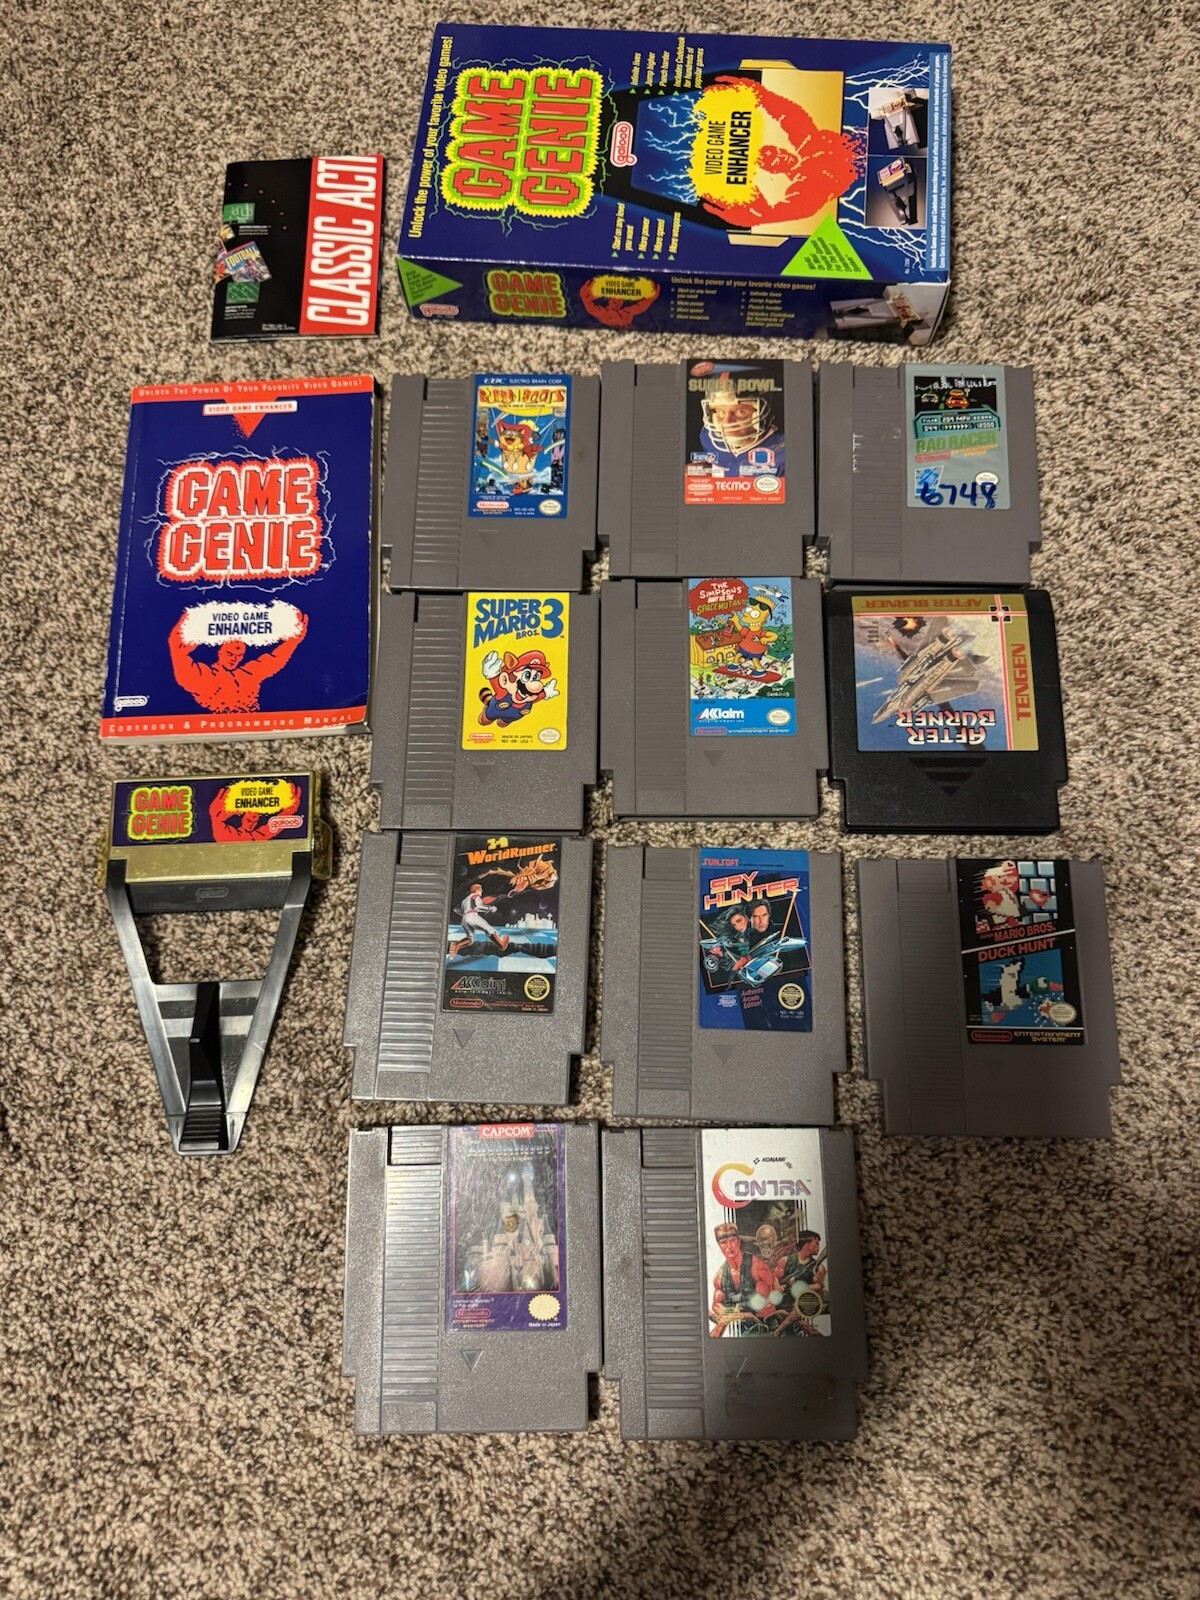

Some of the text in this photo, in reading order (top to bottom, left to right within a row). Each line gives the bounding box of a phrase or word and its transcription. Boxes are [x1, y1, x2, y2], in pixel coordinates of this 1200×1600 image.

[673, 37, 685, 87] Includes Codebook
[694, 48, 704, 88] popular games
[645, 71, 655, 86] Jump
[660, 70, 668, 87] Punch
[408, 36, 453, 237] Unlock the power of your favorite video games!
[452, 75, 526, 199] GAME
[520, 75, 593, 206] GENIE
[616, 126, 634, 164] galoob
[705, 121, 725, 174] VIDEO GAME
[726, 111, 751, 185] ENHANCER
[638, 217, 650, 251] More power
[654, 219, 665, 252] More speed
[669, 212, 681, 253] More weapons
[306, 216, 375, 326] CLASSIC
[492, 272, 560, 295] GAME
[601, 287, 641, 297] ENHANCER
[621, 281, 635, 289] GAME
[773, 281, 790, 289] video
[493, 293, 564, 315] GENIE
[688, 379, 776, 391] SUPER BOWL
[950, 430, 996, 449] RACER
[177, 469, 311, 517] GAME
[715, 481, 751, 491] TECMO
[170, 521, 314, 571] GENIE
[700, 587, 742, 599] SIMPSONS
[865, 598, 983, 608] AFTER BURNER
[213, 611, 269, 622] VIDEO GAME
[475, 598, 563, 638] SUPER 3
[208, 622, 272, 636] ENHANCER
[474, 613, 540, 649] MARIO
[516, 630, 540, 640] BROS.
[1011, 643, 1032, 721] TENGEN
[116, 697, 147, 711] galoob
[896, 709, 996, 728] BURNER
[906, 726, 987, 745] AFTER
[135, 790, 190, 811] GAME
[241, 787, 273, 796] VIDEO GAME
[235, 797, 280, 808] ENHANCER
[133, 813, 190, 834] GENIE
[271, 817, 301, 832] galoob
[467, 843, 556, 865] WorldRunner
[702, 858, 739, 866] SUNSOFT
[710, 871, 759, 894] SPY
[704, 878, 801, 910] HUNTER
[994, 928, 1025, 941] MARIO
[1027, 921, 1056, 935] BROS.
[978, 937, 1055, 962] DUCK HUNT
[482, 1127, 530, 1136] CAPCOM
[712, 1162, 811, 1208] CONTRA
